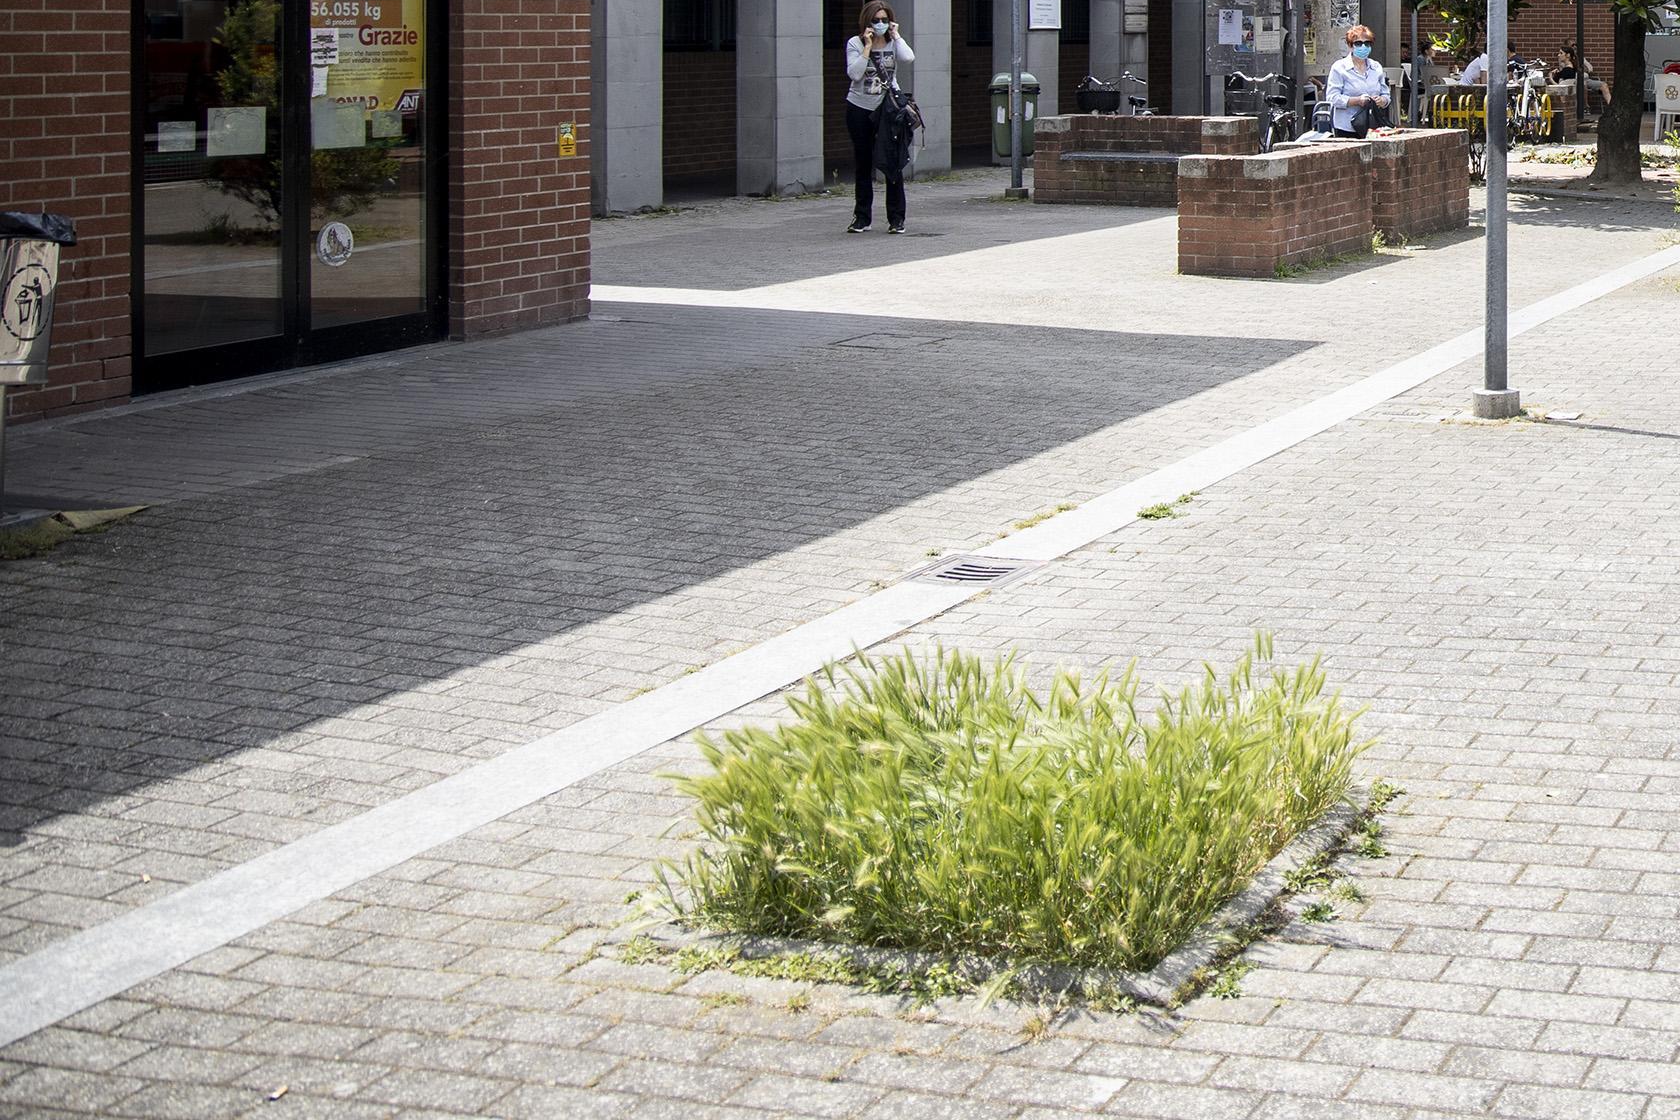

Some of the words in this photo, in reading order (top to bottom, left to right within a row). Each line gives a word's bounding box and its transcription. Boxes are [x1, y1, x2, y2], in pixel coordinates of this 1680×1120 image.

[364, 2, 381, 21] kg
[325, 18, 332, 26] di
[332, 18, 357, 27] prodotti
[359, 24, 418, 47] Grazie
[397, 96, 419, 111] ANT
